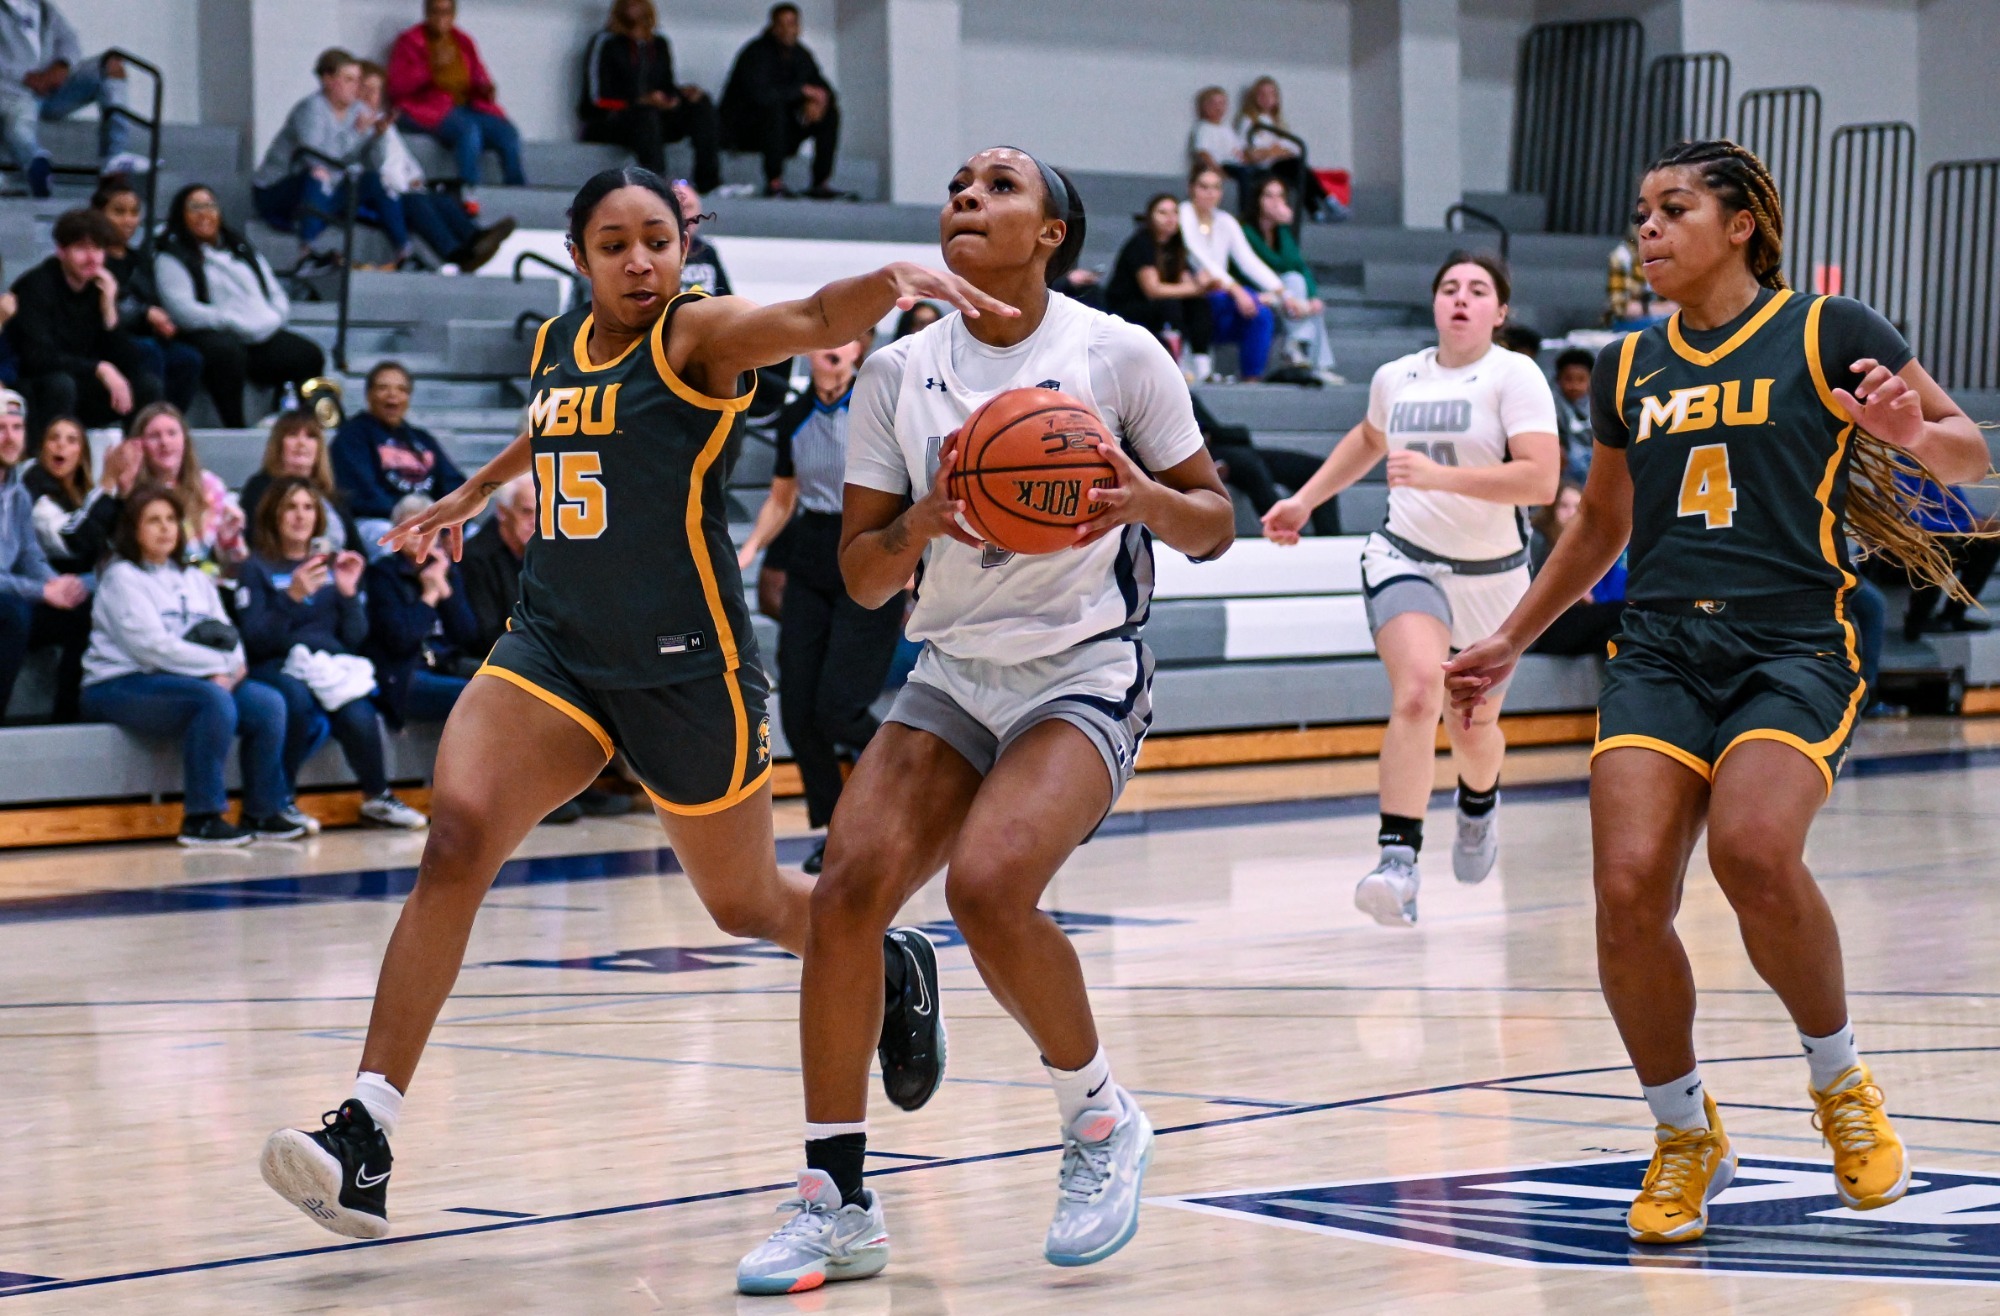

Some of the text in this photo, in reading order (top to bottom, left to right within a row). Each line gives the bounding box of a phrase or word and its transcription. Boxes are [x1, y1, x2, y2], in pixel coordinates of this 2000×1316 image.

[528, 383, 622, 438] MBU
[1389, 399, 1473, 434] HOOD
[1635, 378, 1776, 444] MBU
[535, 451, 608, 540] 15
[1016, 479, 1082, 517] ROCK
[1677, 442, 1738, 530] 4
[691, 636, 701, 647] M
